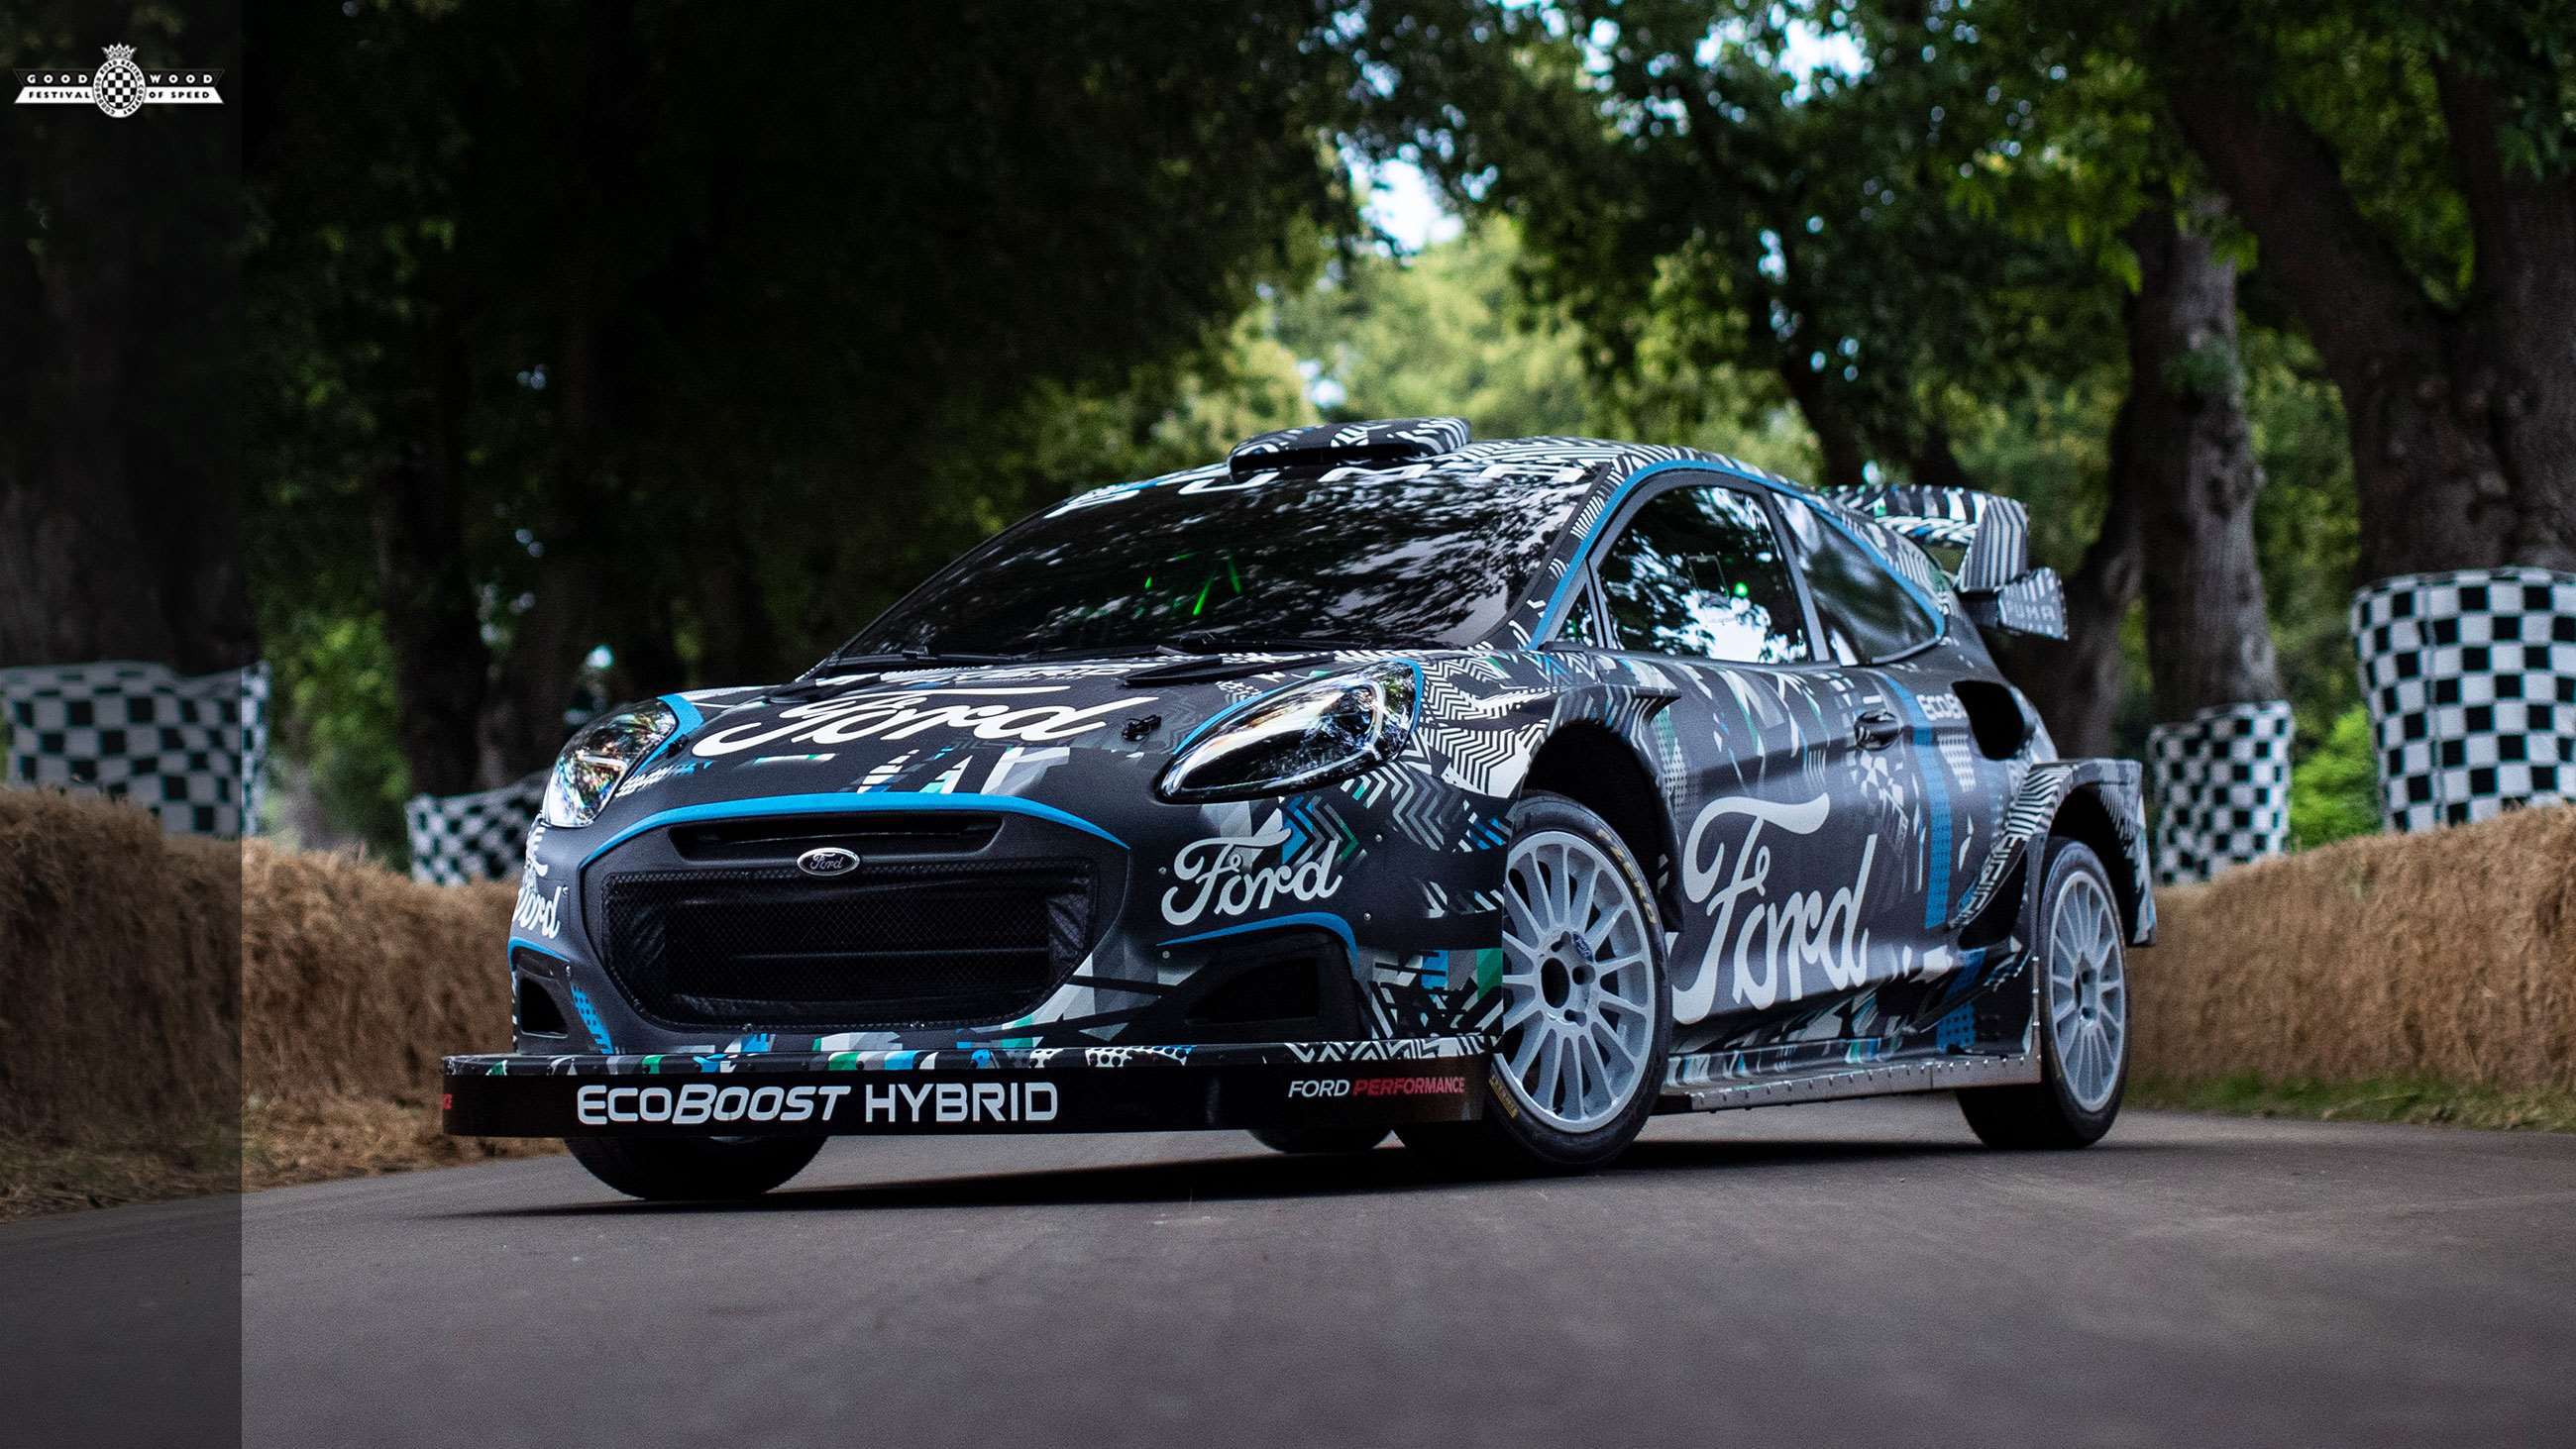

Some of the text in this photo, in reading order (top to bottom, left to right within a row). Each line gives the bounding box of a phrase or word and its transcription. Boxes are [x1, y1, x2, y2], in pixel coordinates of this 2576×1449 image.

[693, 685, 1159, 757] Ford
[810, 852, 844, 870] Ford
[1161, 827, 1343, 926] Ford
[1664, 792, 1878, 1025] Ford
[865, 1082, 1059, 1123] HYBRID
[1288, 1079, 1351, 1098] FORD
[1351, 1076, 1466, 1097] PERFORMANCE
